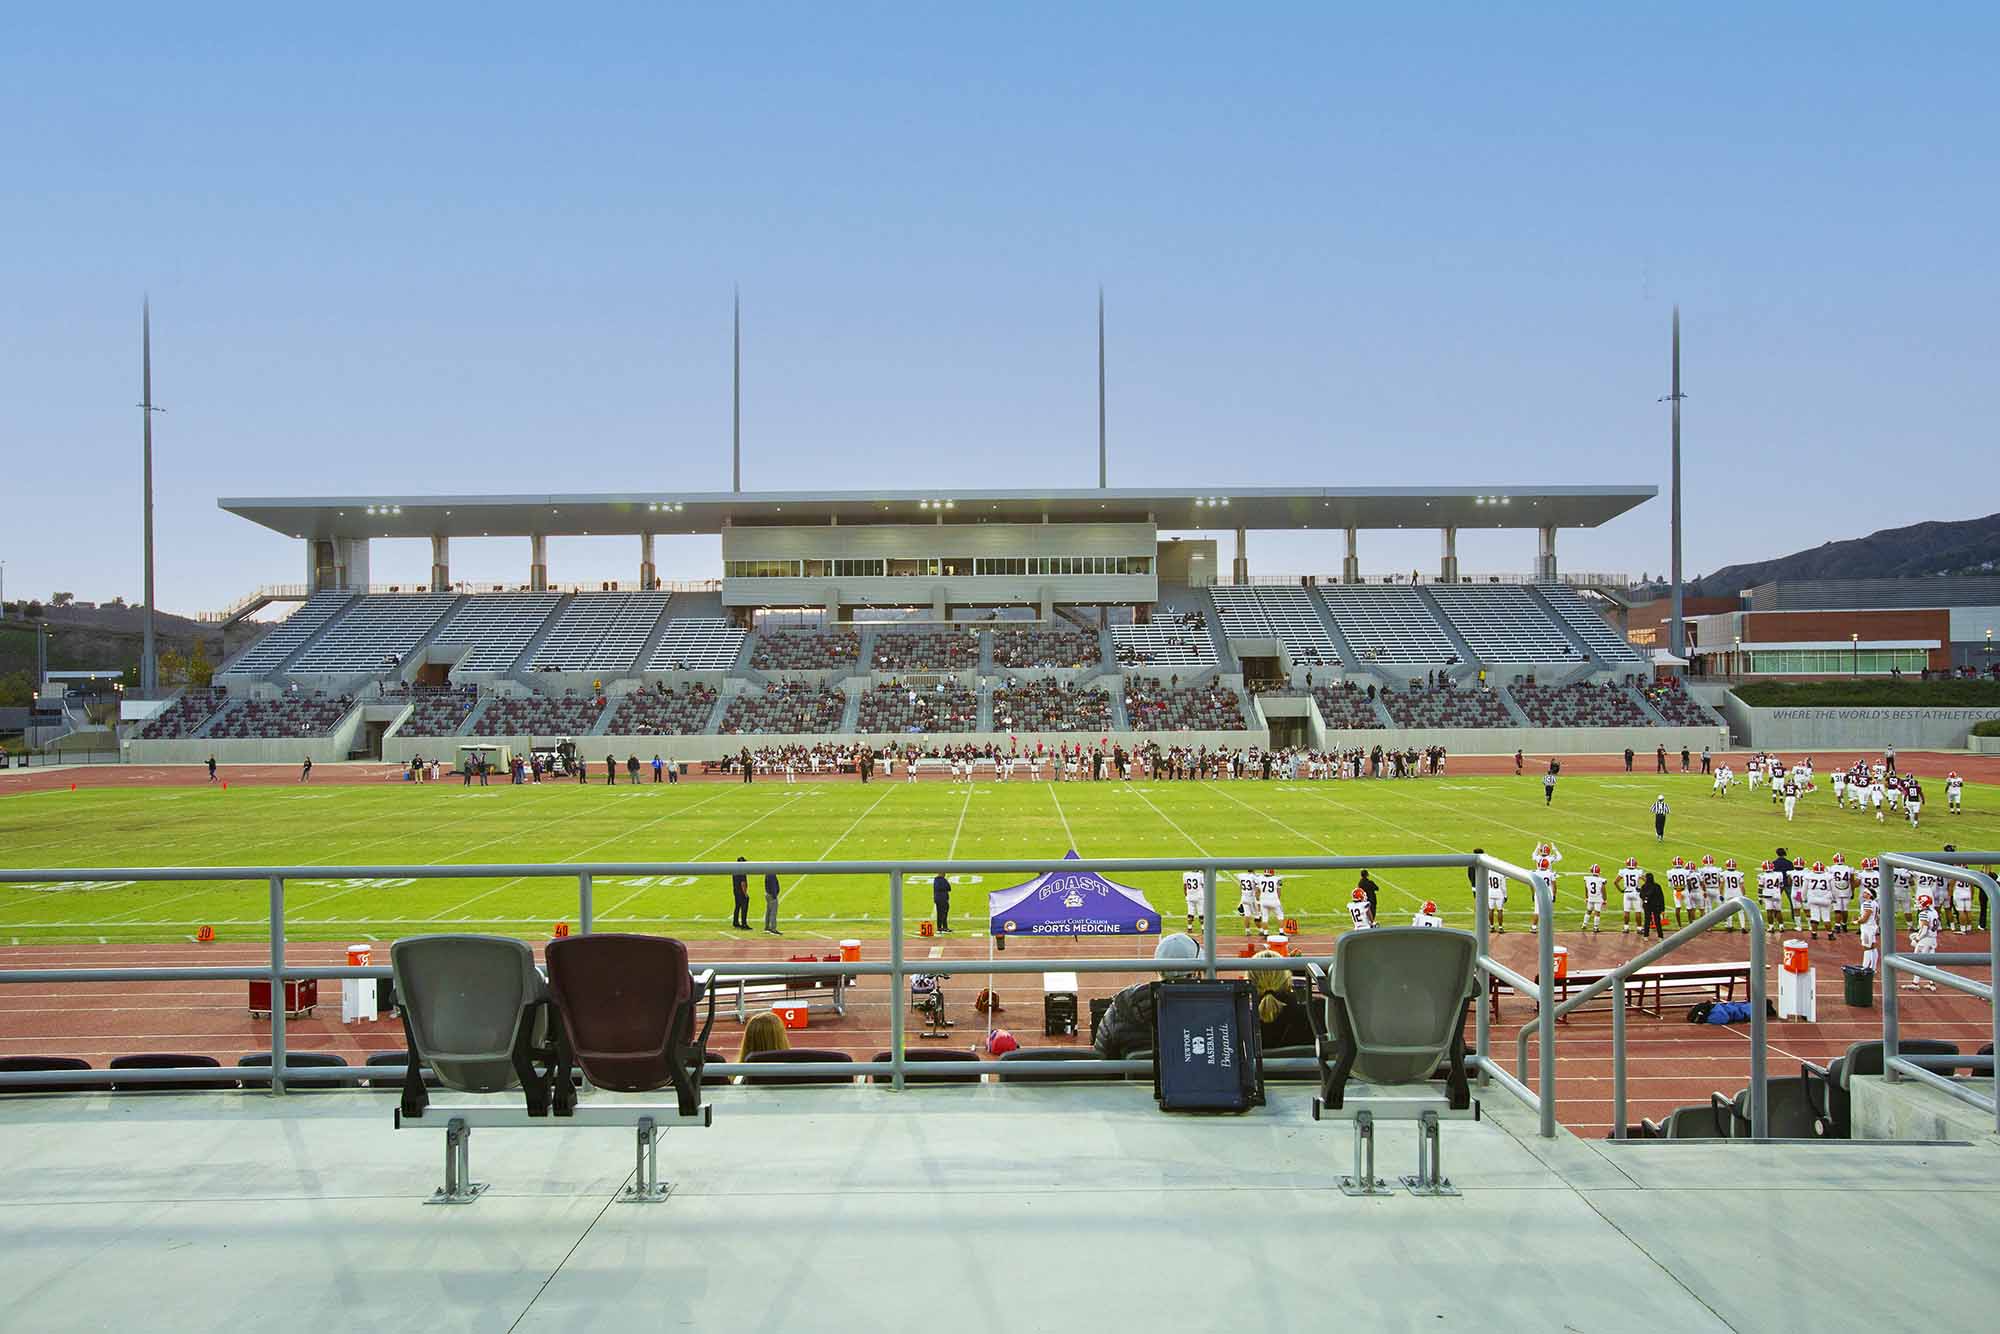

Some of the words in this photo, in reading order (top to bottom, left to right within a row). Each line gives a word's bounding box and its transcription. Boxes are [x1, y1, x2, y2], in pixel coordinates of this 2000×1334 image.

[1773, 711, 1811, 719] WHERE
[1815, 711, 1837, 719] THE
[1839, 711, 1889, 720] WORLD'S
[1893, 711, 1920, 719] BEST
[1922, 711, 1983, 719] ATHLETES
[1186, 878, 1199, 890] 63
[1625, 874, 1637, 887] 15
[1671, 874, 1685, 887] 88
[1703, 872, 1717, 885] 25
[1727, 876, 1738, 889] 19
[1766, 878, 1779, 889] 24
[1811, 879, 1827, 890] 73
[1864, 877, 1879, 888] 59
[1919, 876, 1933, 886] 27
[1039, 876, 1109, 901] COAST
[1240, 879, 1253, 891] 53
[1261, 880, 1275, 893] 79
[1590, 881, 1597, 894] 3
[1350, 908, 1362, 922] 12
[921, 924, 933, 936] 50
[1032, 925, 1070, 933] SPORTS
[1073, 925, 1120, 933] MEDICINE
[785, 1010, 795, 1020] G
[1206, 1026, 1215, 1065] BASEBALL
